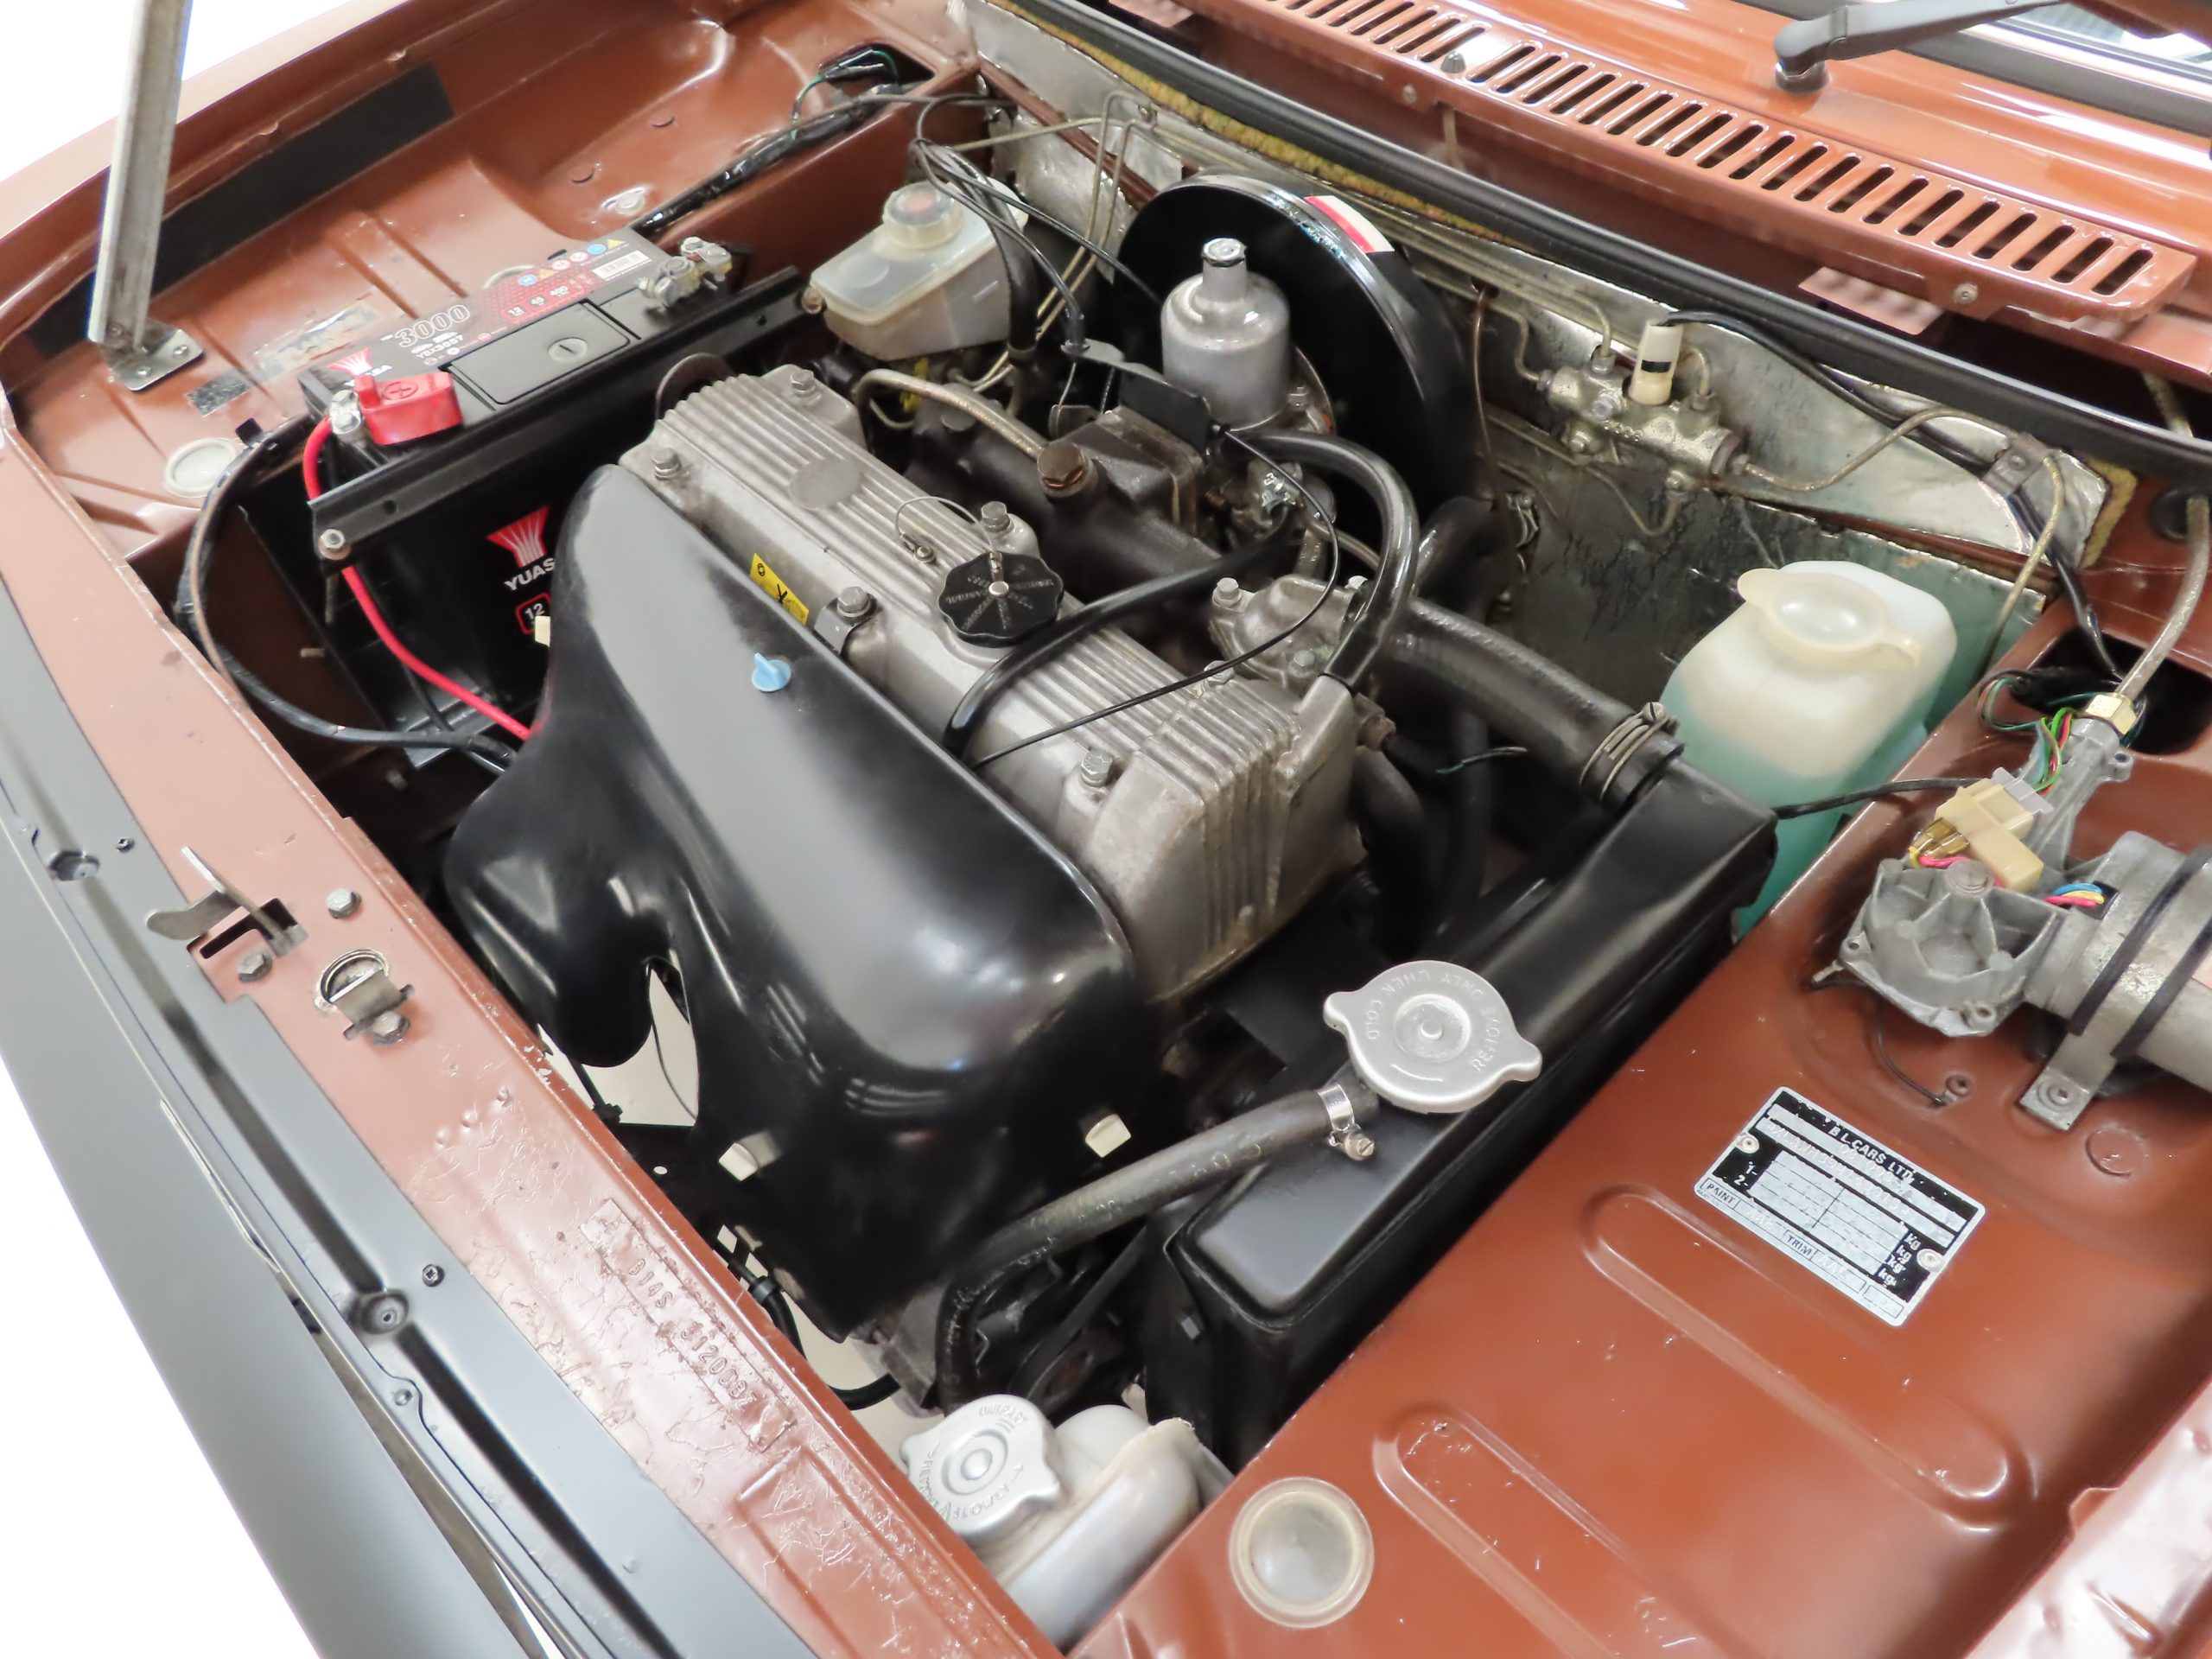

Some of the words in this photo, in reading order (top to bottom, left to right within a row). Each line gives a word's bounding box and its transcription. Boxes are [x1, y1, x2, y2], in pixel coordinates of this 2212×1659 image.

[395, 305, 470, 347] 3000
[504, 557, 555, 590] YUAS
[1706, 1183, 1736, 1204] PAINT
[1786, 1235, 1813, 1256] TRIM
[1896, 1244, 1912, 1264] kg
[1904, 1232, 1922, 1251] kg
